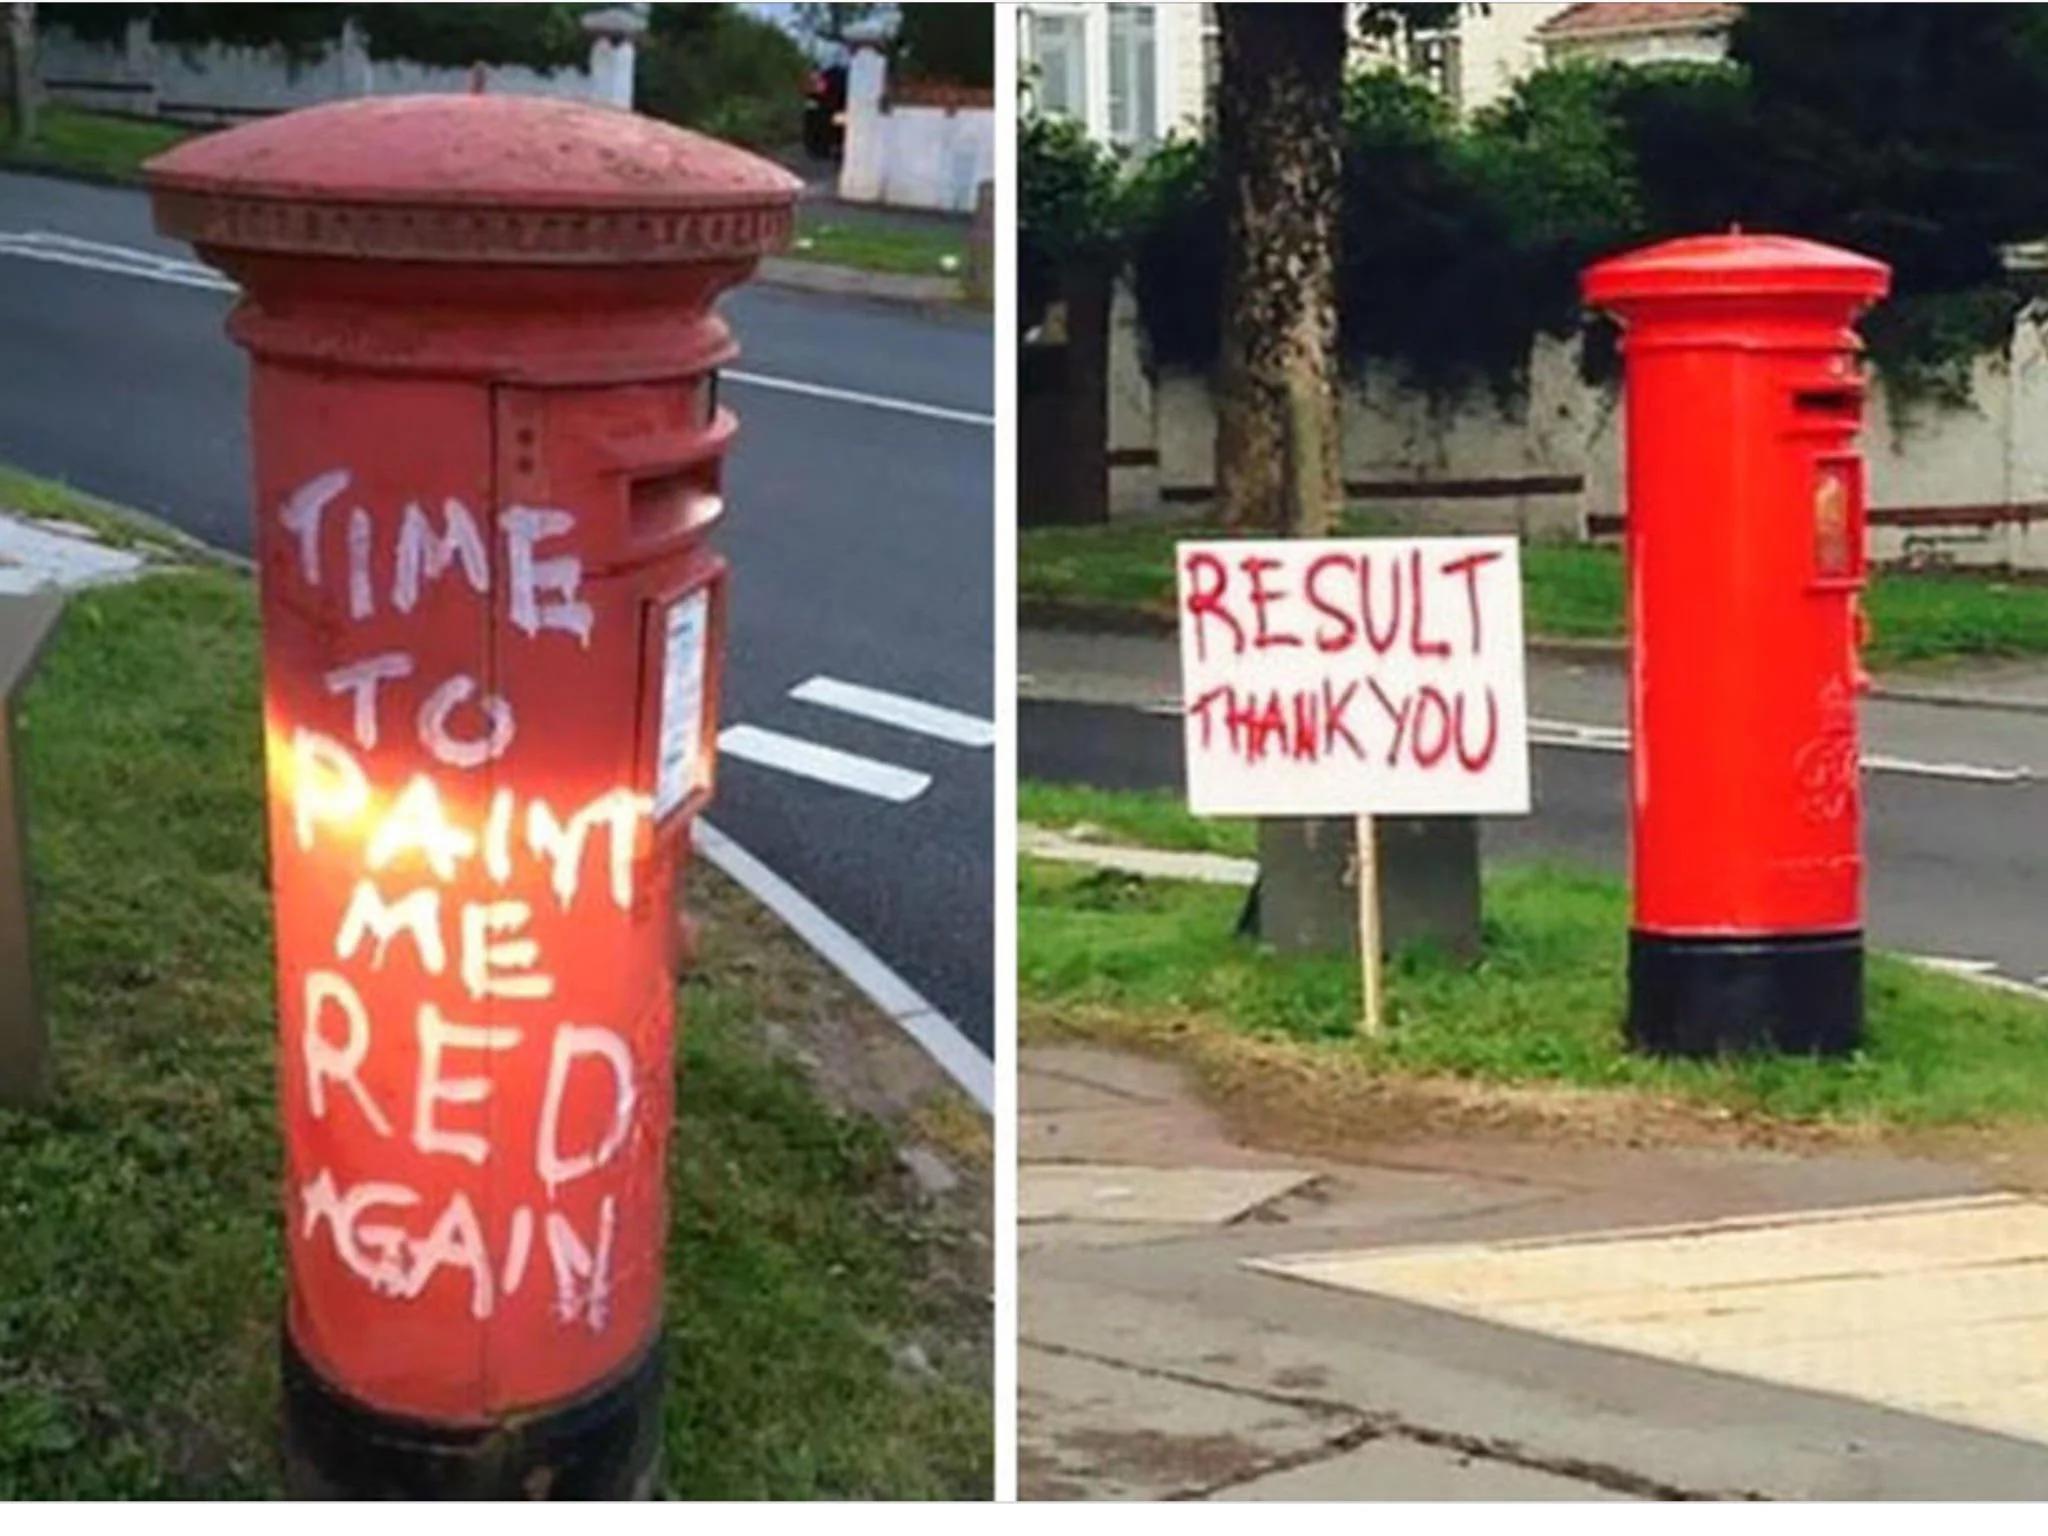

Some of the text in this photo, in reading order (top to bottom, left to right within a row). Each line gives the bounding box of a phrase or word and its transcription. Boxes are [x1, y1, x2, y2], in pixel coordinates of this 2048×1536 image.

[281, 469, 594, 649] TIME
[1186, 548, 1502, 662] RESULT
[325, 652, 515, 767] TO
[1190, 675, 1497, 772] THANK YOU
[293, 725, 654, 911] PAINT
[335, 879, 554, 1001] ME
[304, 970, 637, 1199] RED
[303, 1168, 614, 1332] AGAIN
